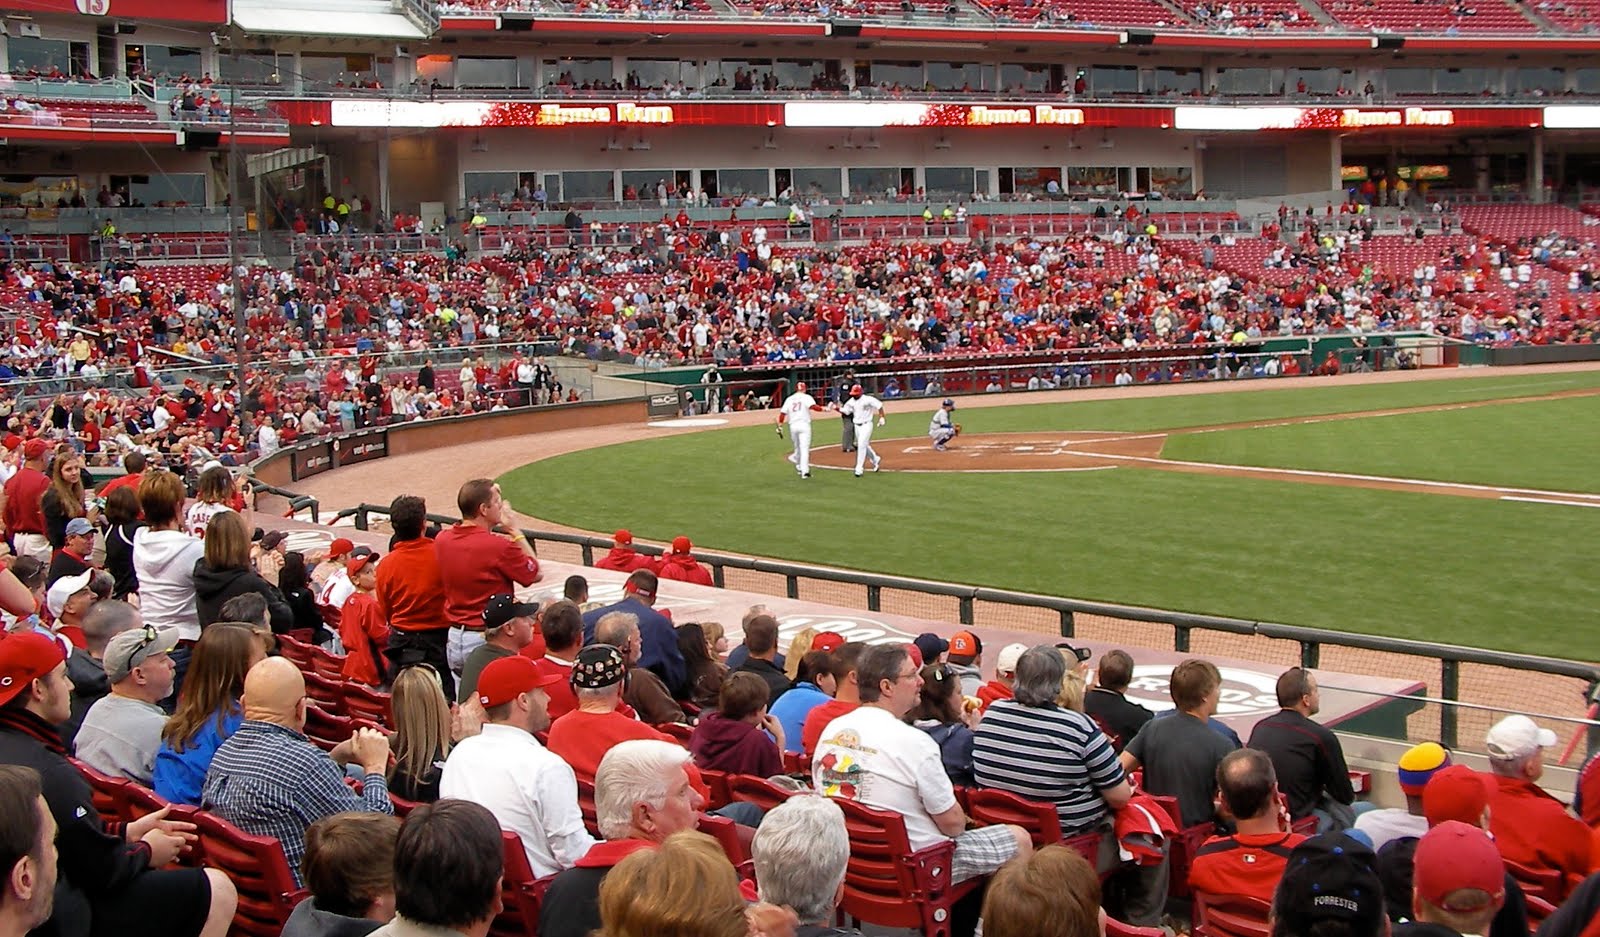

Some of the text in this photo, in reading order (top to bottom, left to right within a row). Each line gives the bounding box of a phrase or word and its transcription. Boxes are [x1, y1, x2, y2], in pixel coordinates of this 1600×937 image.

[617, 103, 674, 123] Run
[1035, 105, 1085, 124] Run
[792, 402, 802, 412] 27
[1127, 677, 1279, 708] RDS
[1313, 895, 1358, 912] FORRESTER
